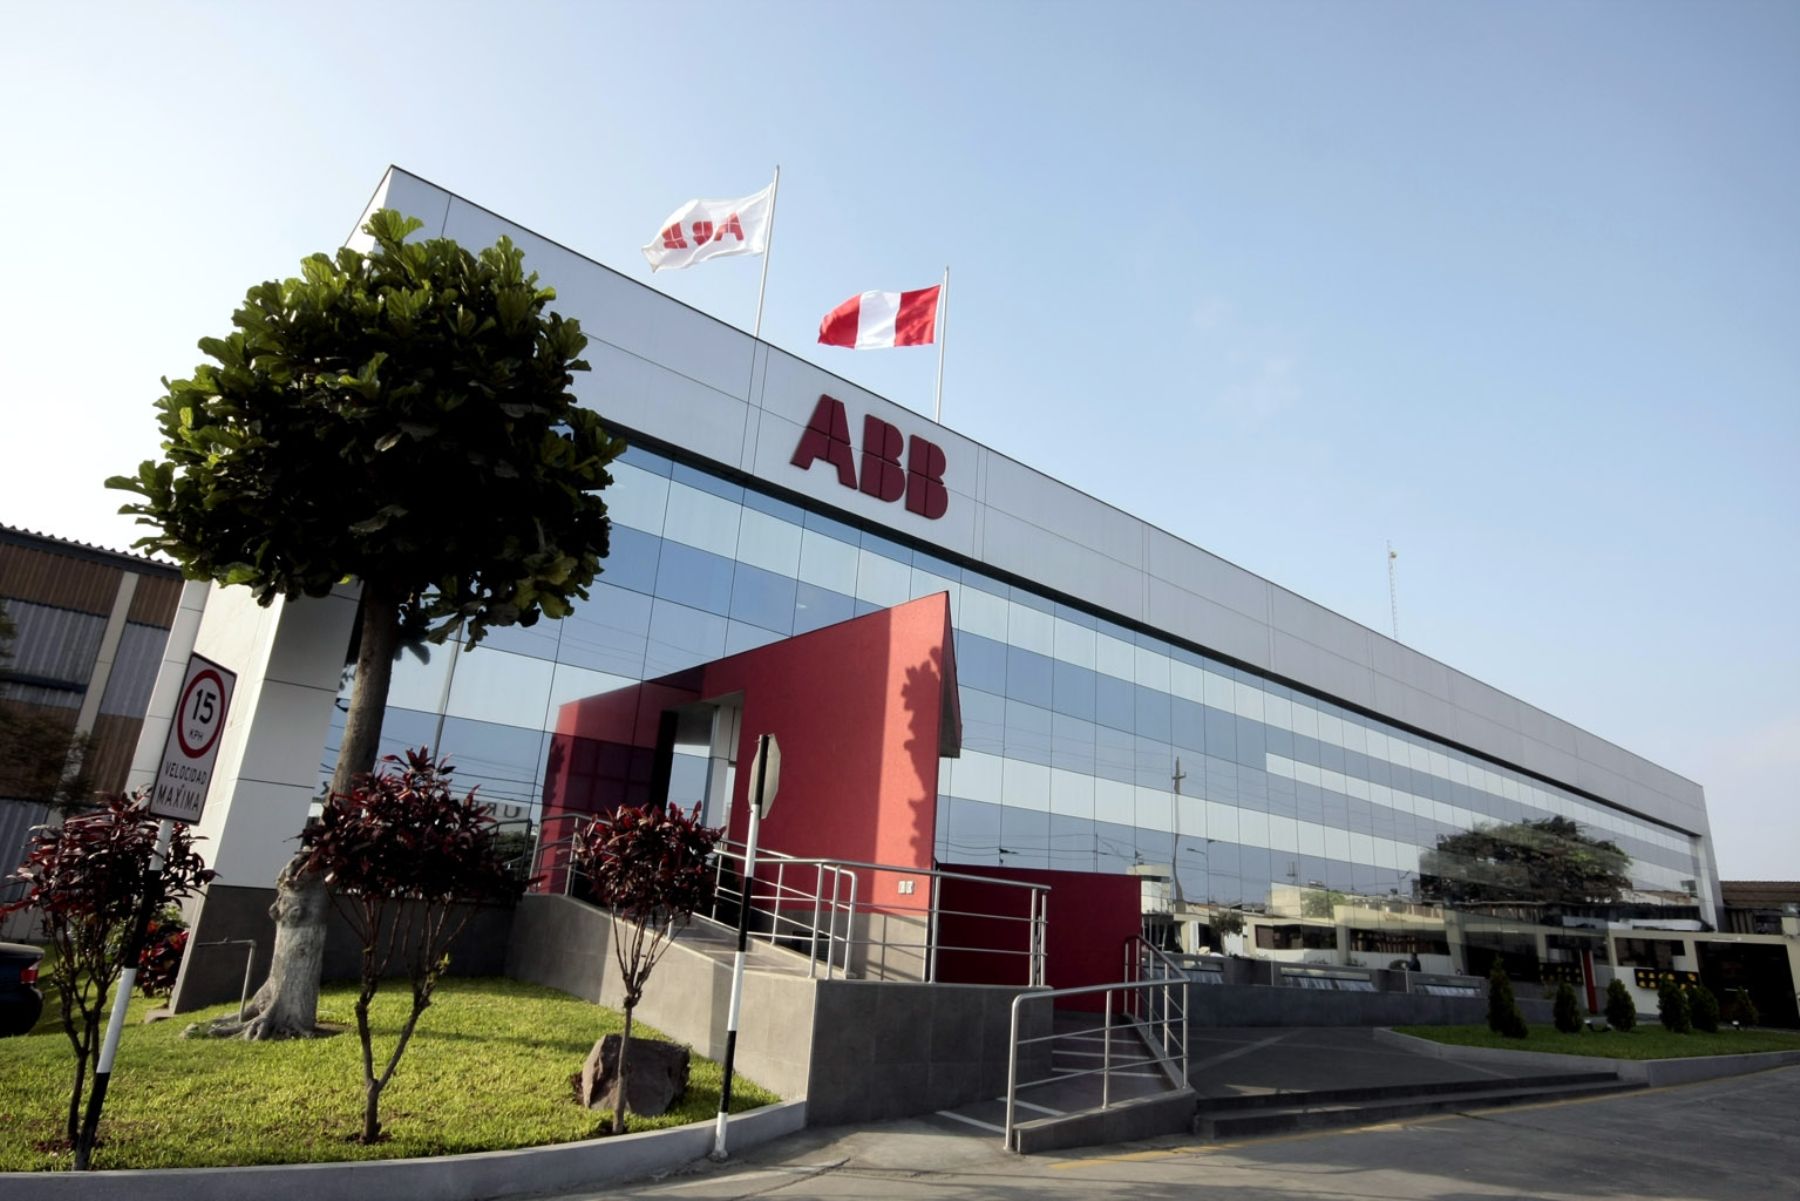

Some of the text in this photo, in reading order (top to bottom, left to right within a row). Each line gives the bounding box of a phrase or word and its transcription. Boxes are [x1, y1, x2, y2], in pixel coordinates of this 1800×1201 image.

[789, 394, 949, 520] ABB
[192, 688, 216, 724] 15
[165, 761, 207, 785] VELOCIDAD
